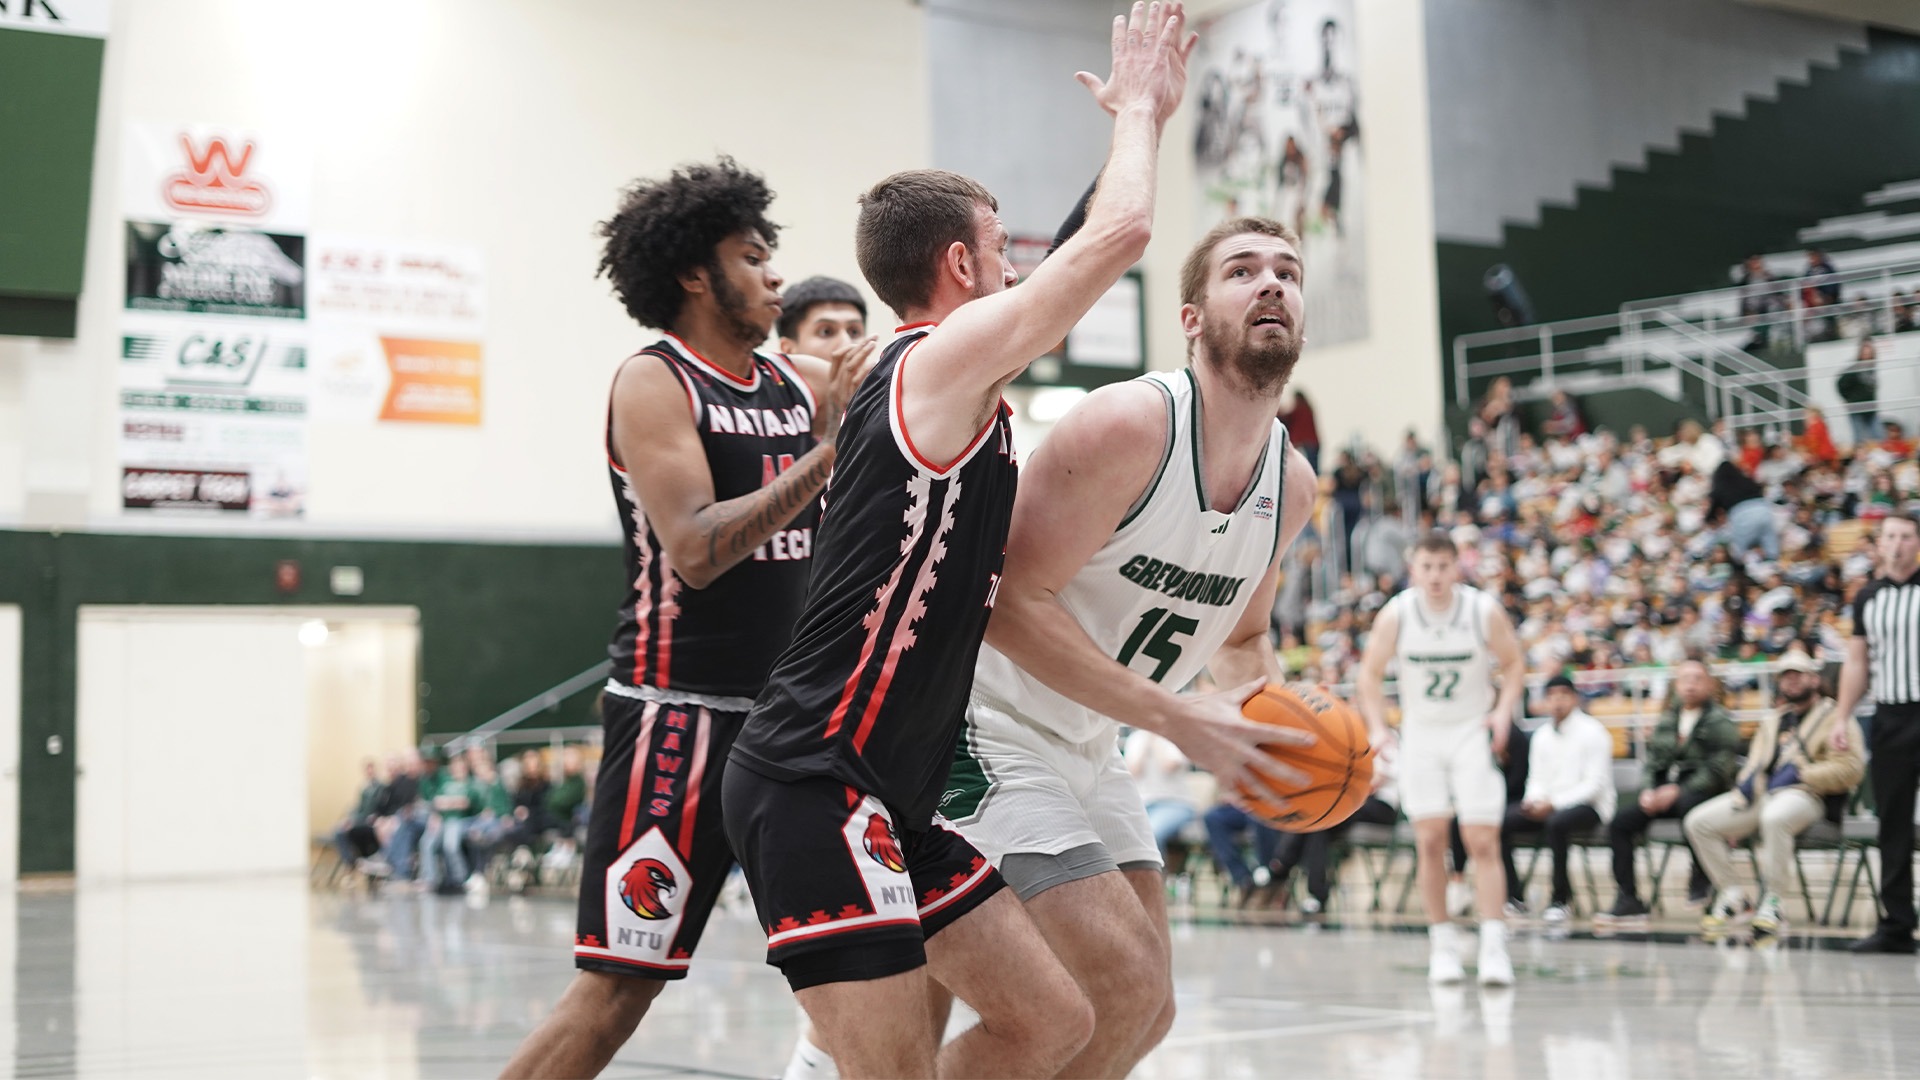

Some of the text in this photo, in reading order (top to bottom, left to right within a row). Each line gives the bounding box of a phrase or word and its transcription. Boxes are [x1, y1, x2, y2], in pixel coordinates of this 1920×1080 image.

[178, 334, 252, 370] C&S
[1116, 607, 1200, 684] 15
[1425, 669, 1460, 701] 22
[881, 885, 914, 905] NTU
[617, 926, 663, 951] NTU
